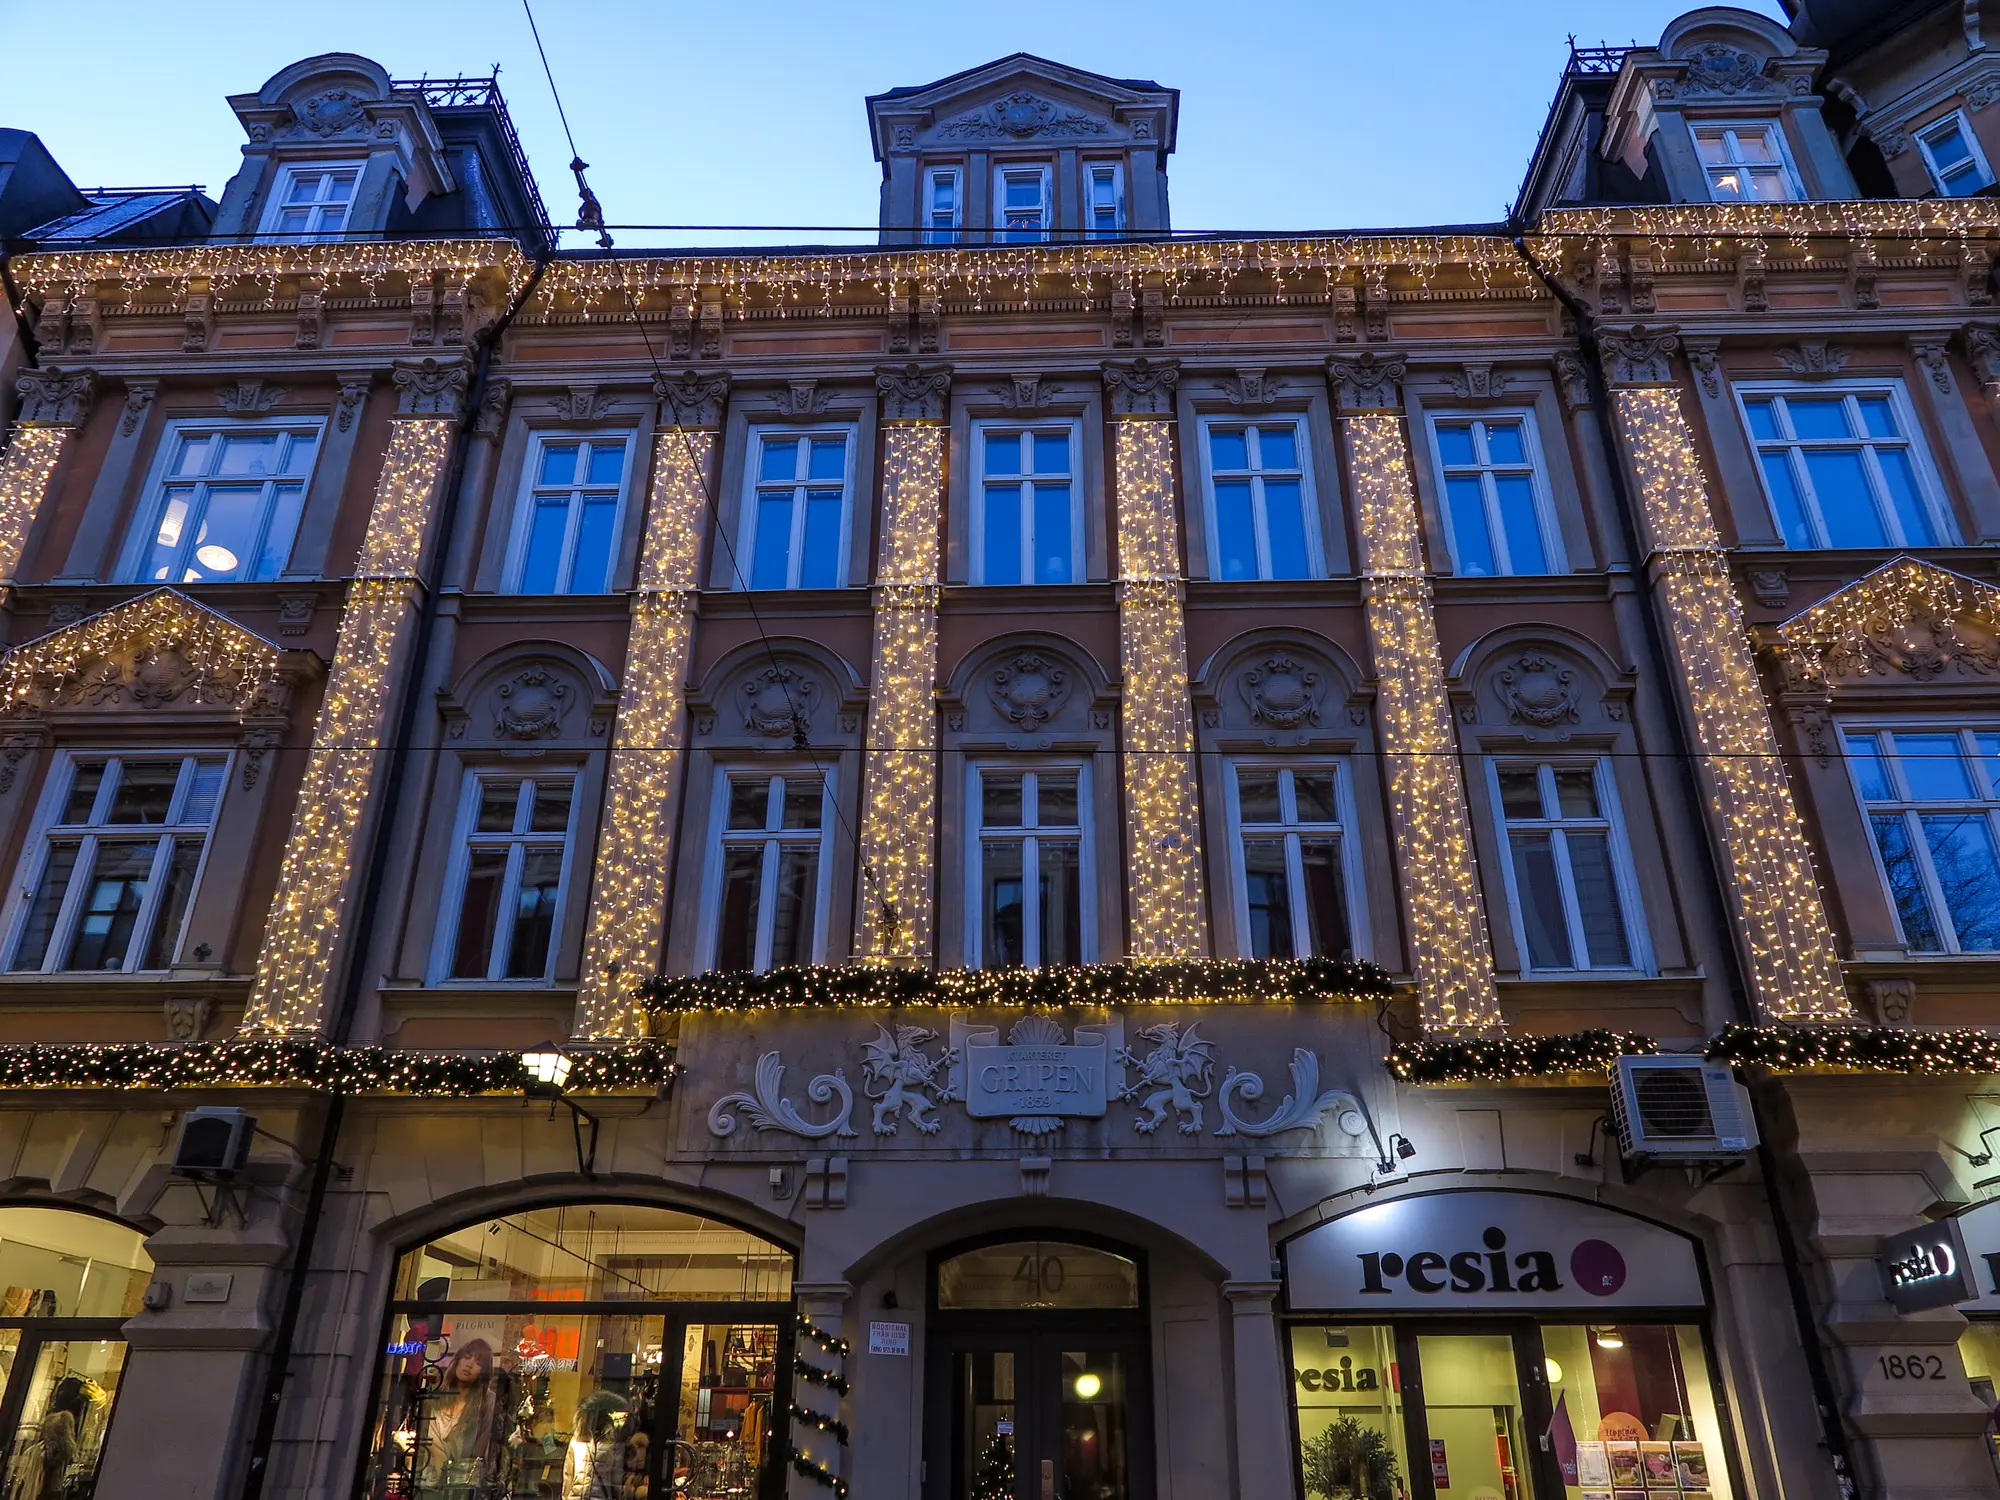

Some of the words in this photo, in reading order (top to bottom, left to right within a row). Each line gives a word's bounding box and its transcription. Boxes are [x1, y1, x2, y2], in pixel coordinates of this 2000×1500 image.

[980, 1064, 1094, 1094] GRIPEN
[1019, 1096, 1052, 1109] 1859
[1356, 1226, 1564, 1294] resia
[1011, 1255, 1064, 1294] 40
[456, 1321, 495, 1330] PILGRIM
[1879, 1354, 1947, 1380] 1862
